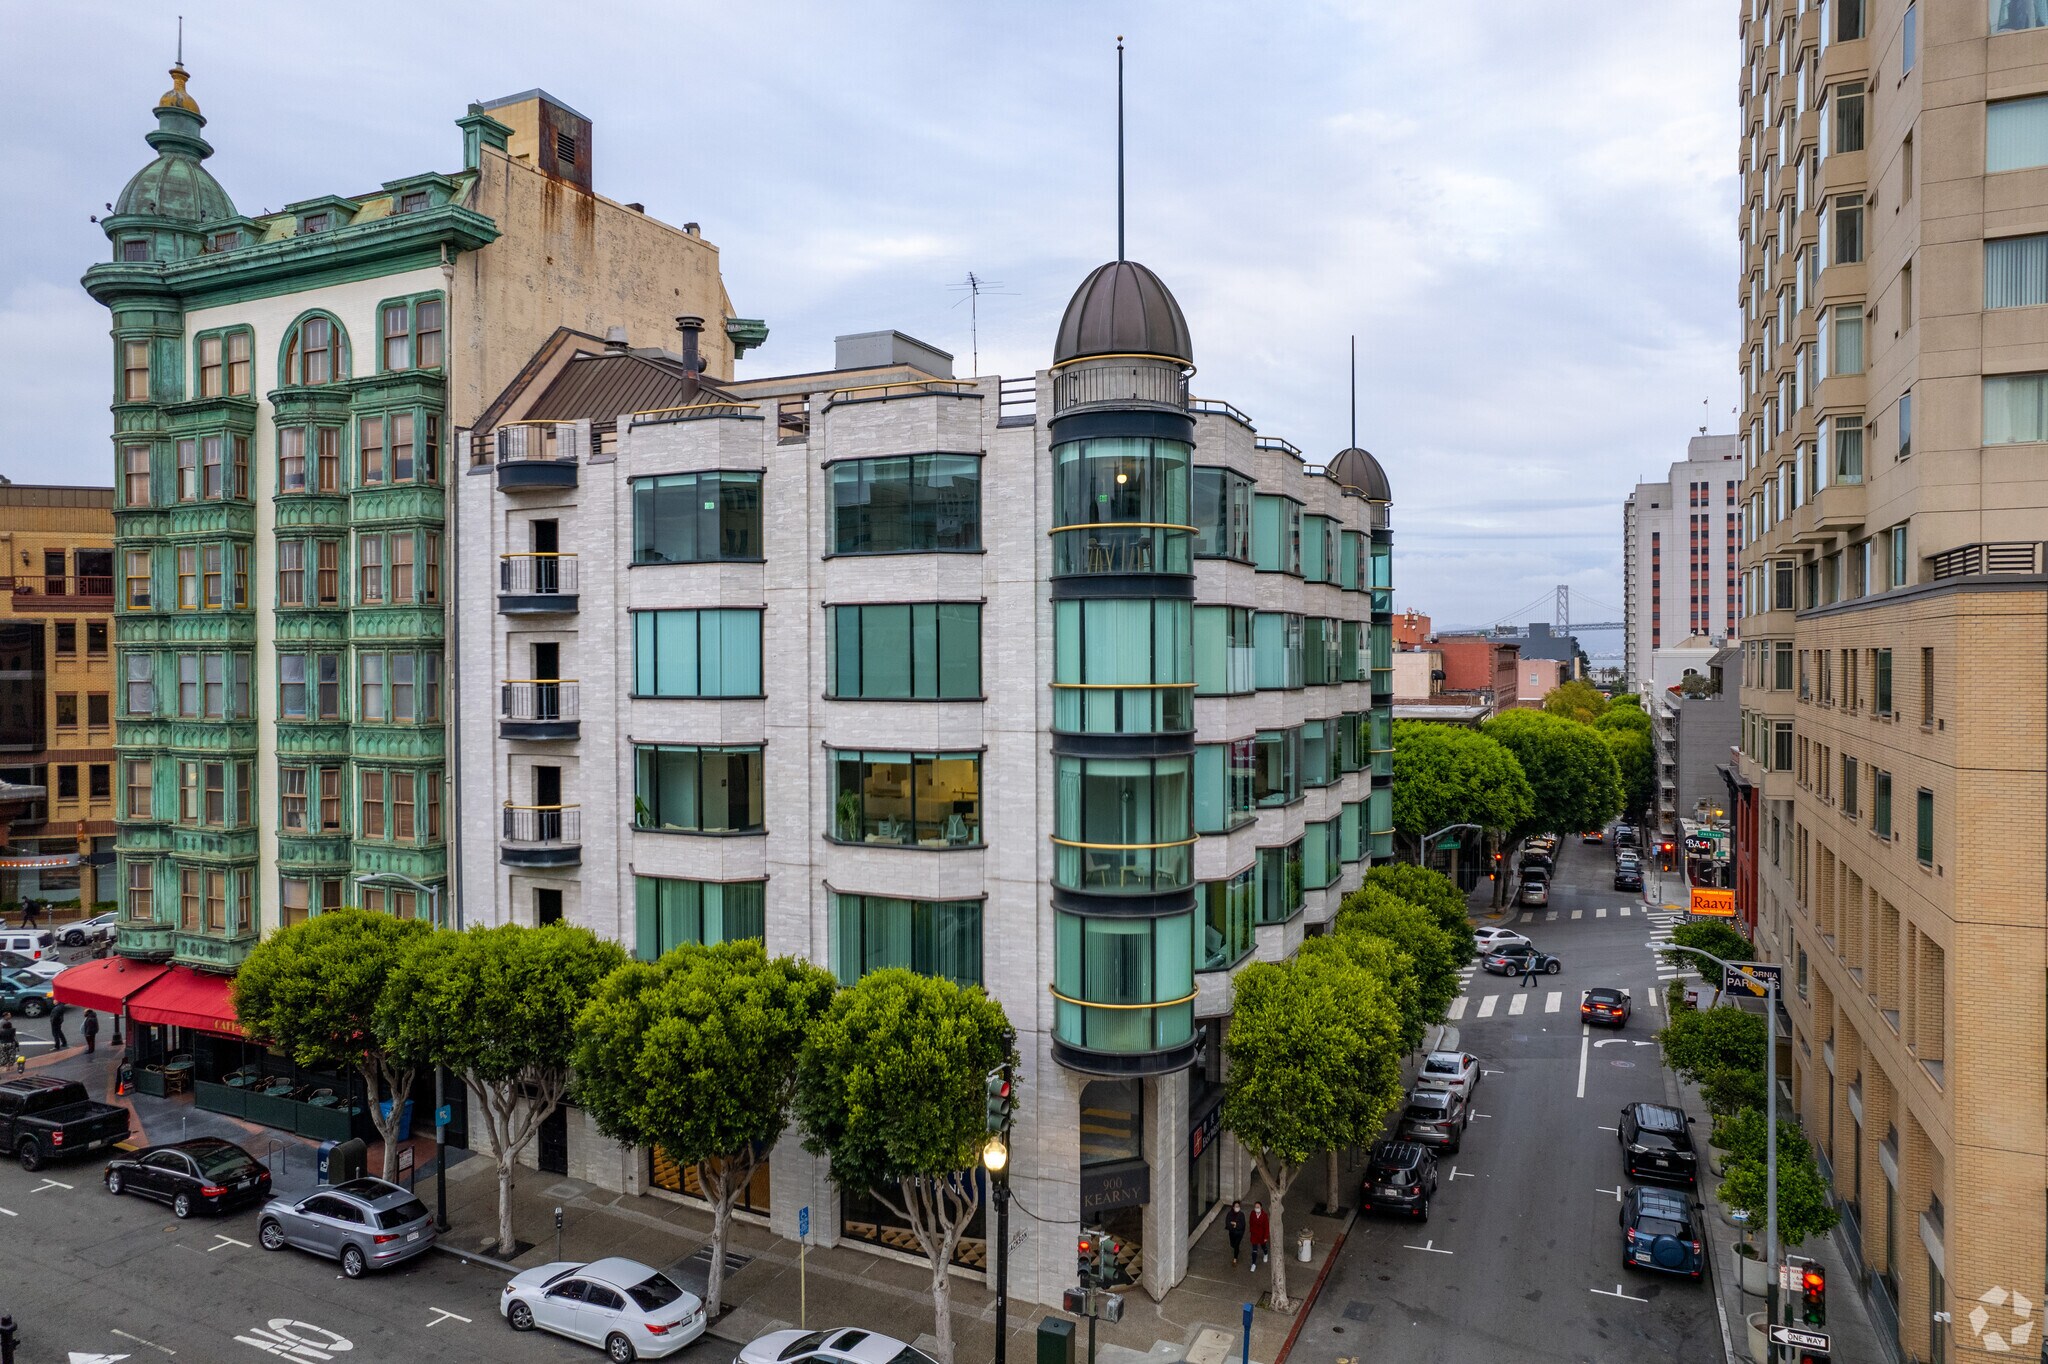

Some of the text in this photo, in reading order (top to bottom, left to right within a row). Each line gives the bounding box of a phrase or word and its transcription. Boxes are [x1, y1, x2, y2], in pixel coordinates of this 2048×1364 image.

[1693, 896, 1732, 910] Raavi
[1103, 1176, 1122, 1191] 900
[1084, 1186, 1141, 1208] KEARNY
[1787, 1333, 1823, 1346] ONE WAY
